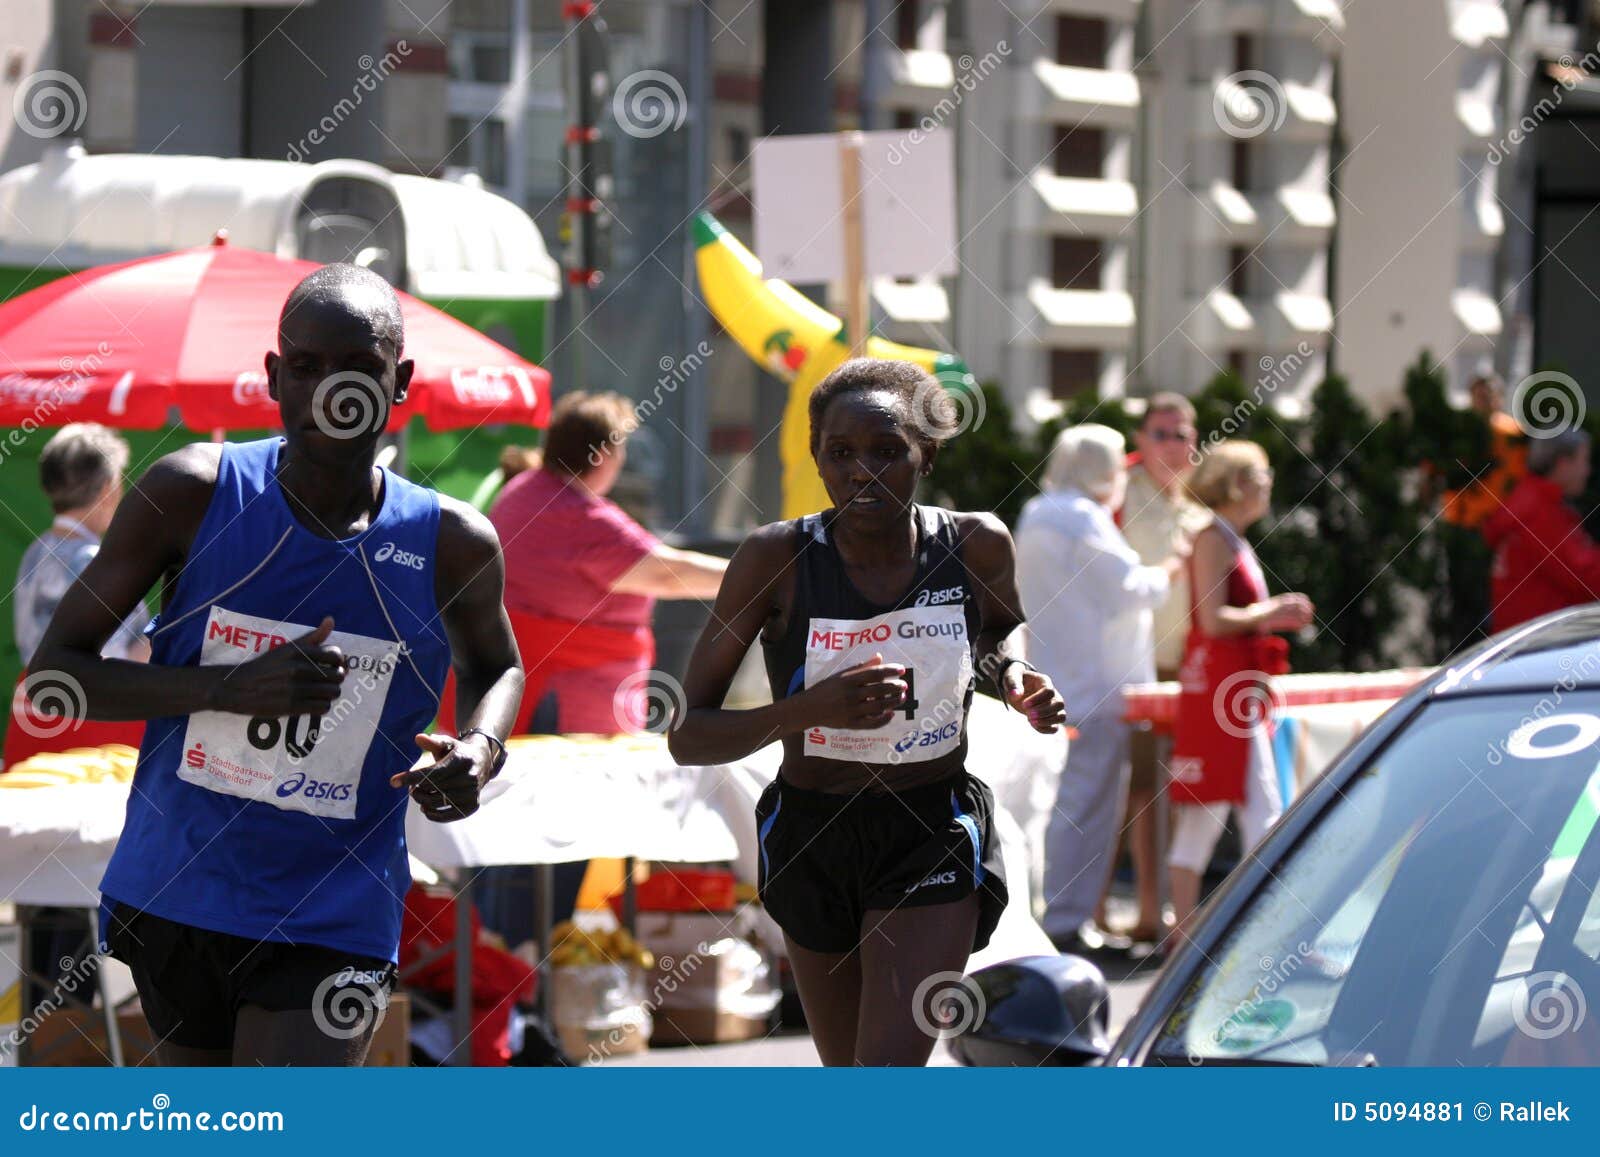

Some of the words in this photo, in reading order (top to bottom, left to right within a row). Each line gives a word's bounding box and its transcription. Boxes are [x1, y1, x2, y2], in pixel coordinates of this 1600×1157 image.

[209, 621, 287, 653] METR
[810, 624, 891, 650] METRO
[897, 621, 964, 640] Group
